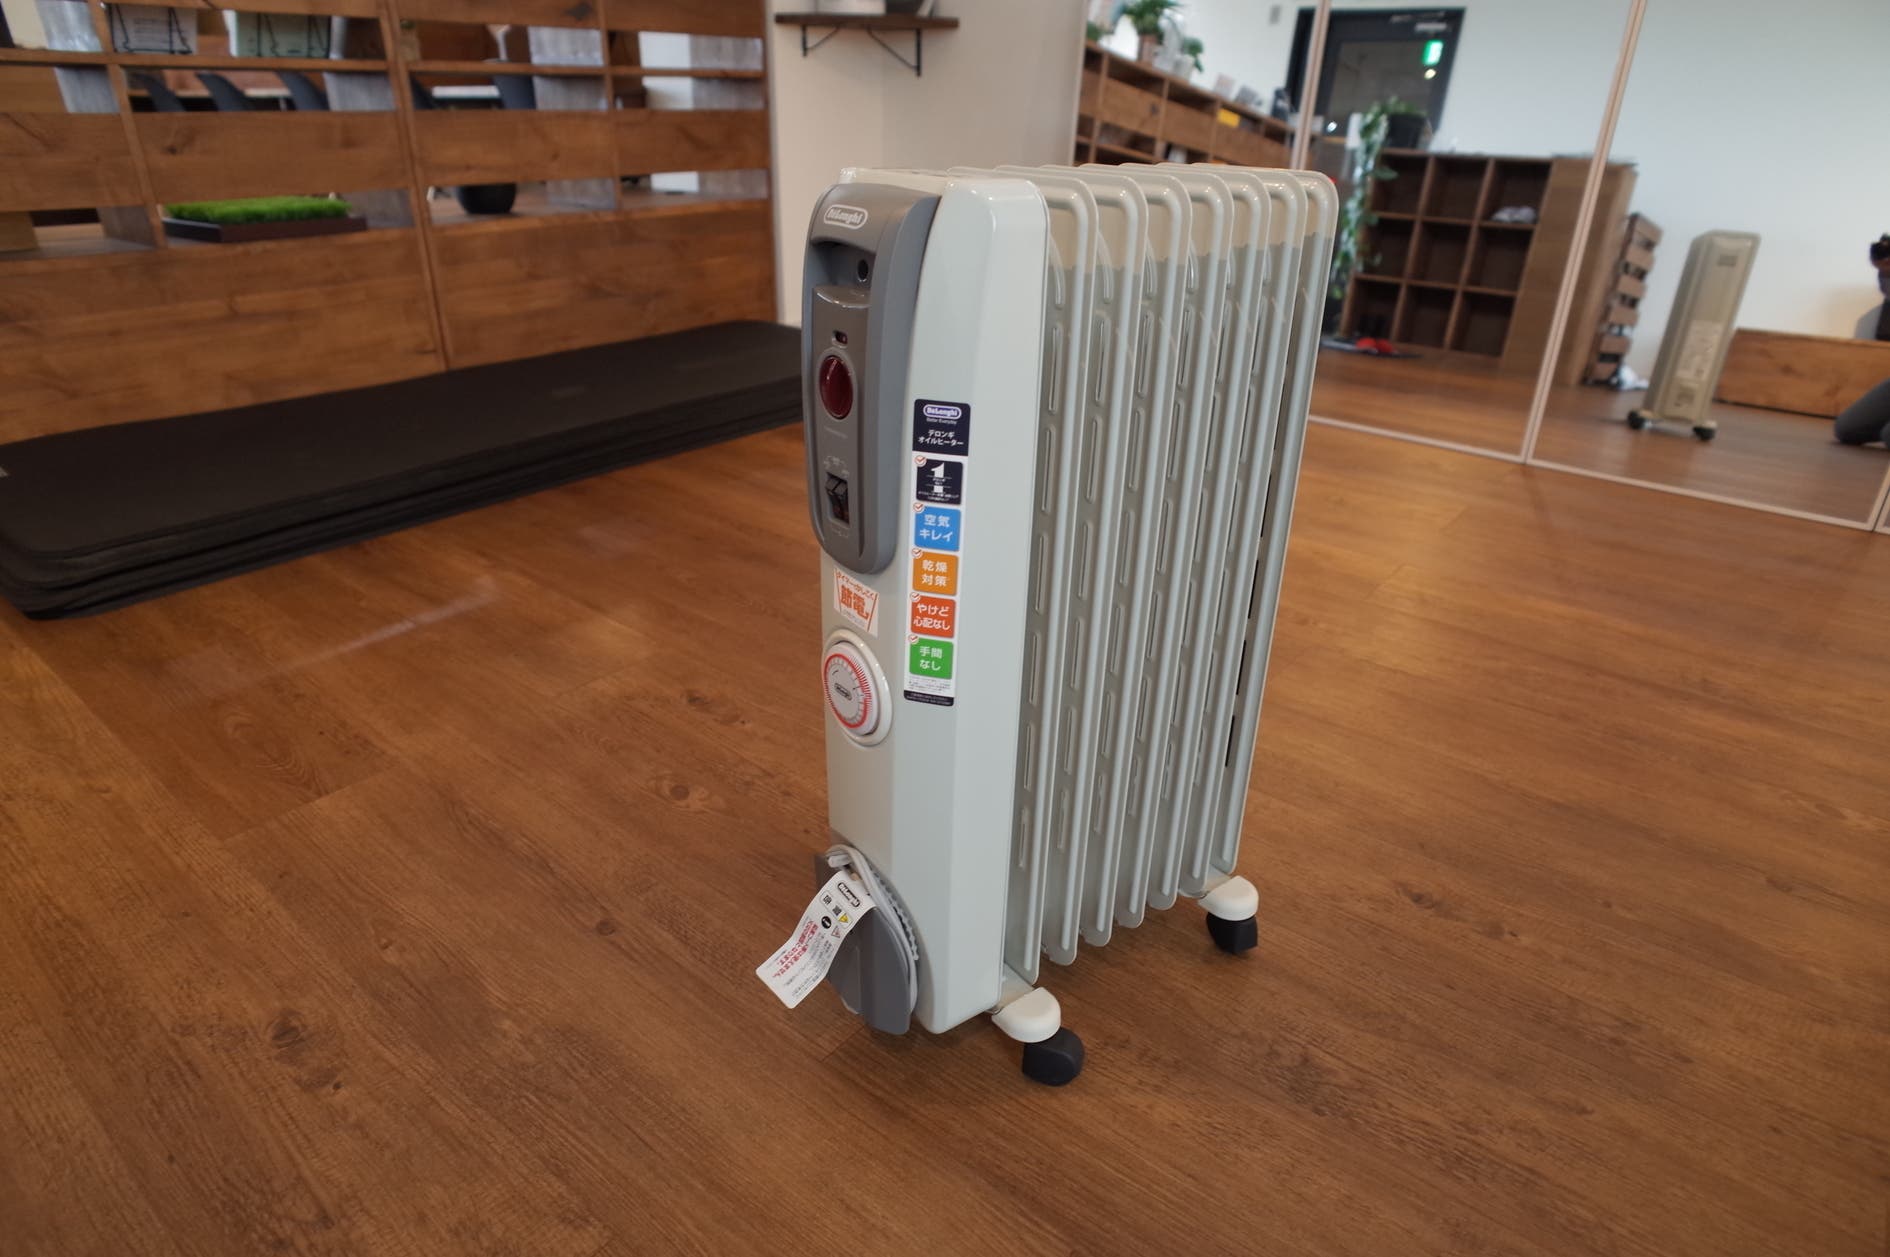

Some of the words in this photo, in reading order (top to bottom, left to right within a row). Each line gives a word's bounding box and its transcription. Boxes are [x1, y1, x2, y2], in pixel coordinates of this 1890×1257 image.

[918, 436, 964, 447] オイルヒーター
[928, 429, 955, 440] デロンギ
[924, 514, 950, 528] 空気
[920, 528, 953, 542] キレイ
[922, 559, 948, 573] 乾燥
[921, 573, 947, 587] 対策
[916, 603, 950, 617] やけど
[913, 615, 951, 631] 心配なし
[919, 646, 943, 659] 手間
[919, 659, 942, 671] なし
